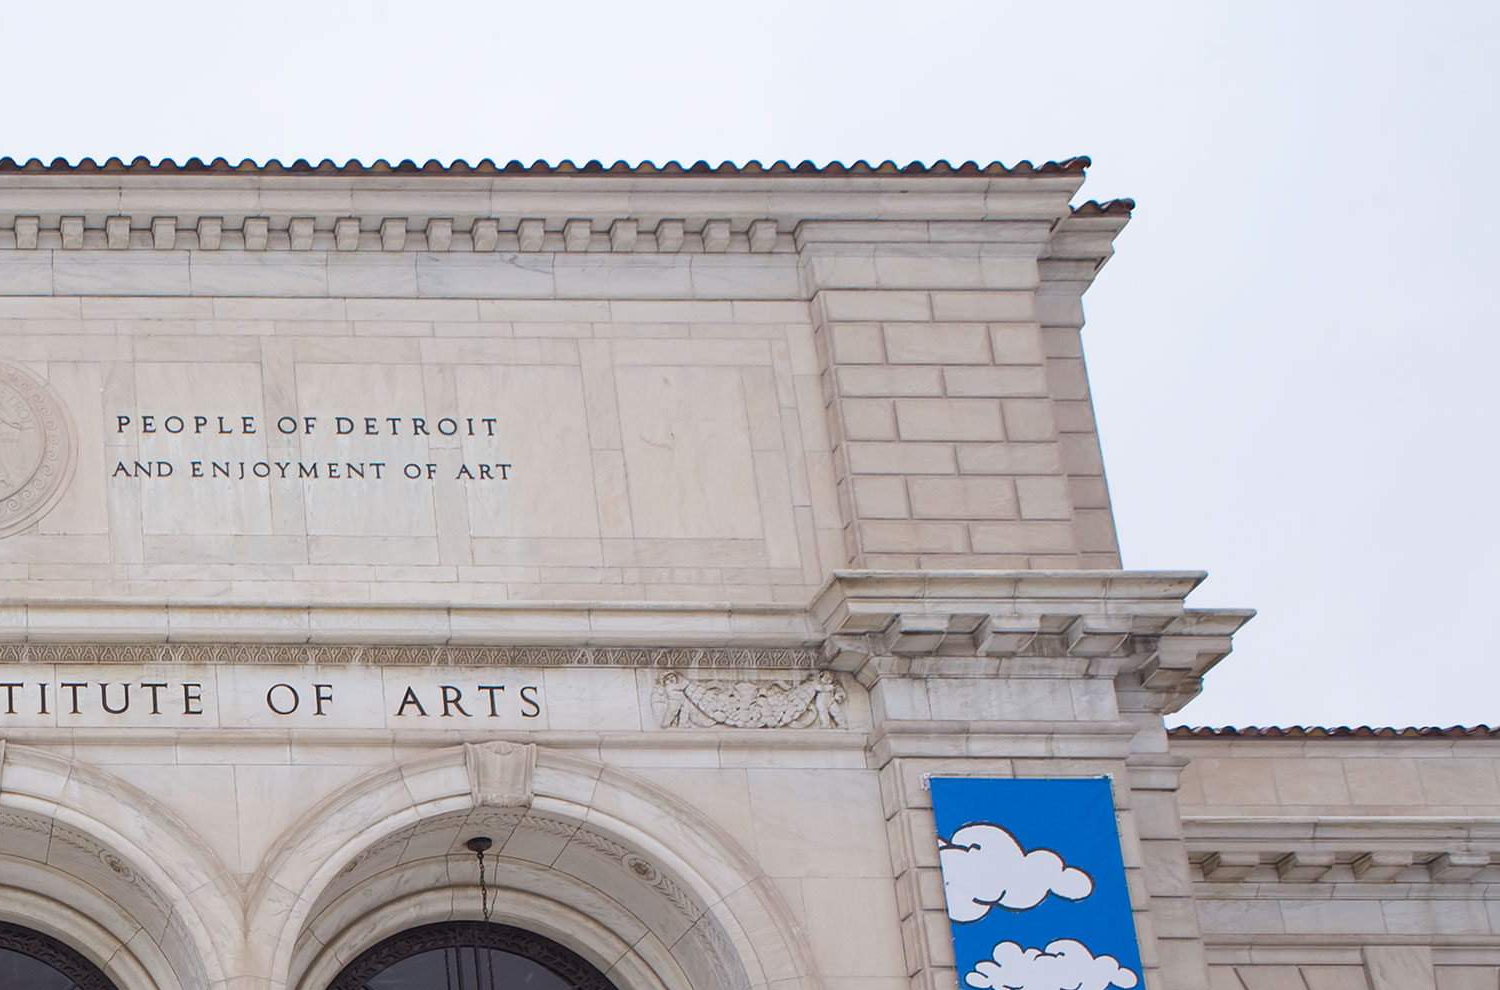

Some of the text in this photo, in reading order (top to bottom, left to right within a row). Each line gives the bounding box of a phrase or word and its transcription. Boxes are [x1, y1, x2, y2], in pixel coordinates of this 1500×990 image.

[117, 415, 497, 436] PEOPLE OF DETROIT
[112, 461, 512, 480] AND ENJOYMENT OF ART
[266, 683, 333, 716] OF
[396, 685, 540, 718] ARTS
